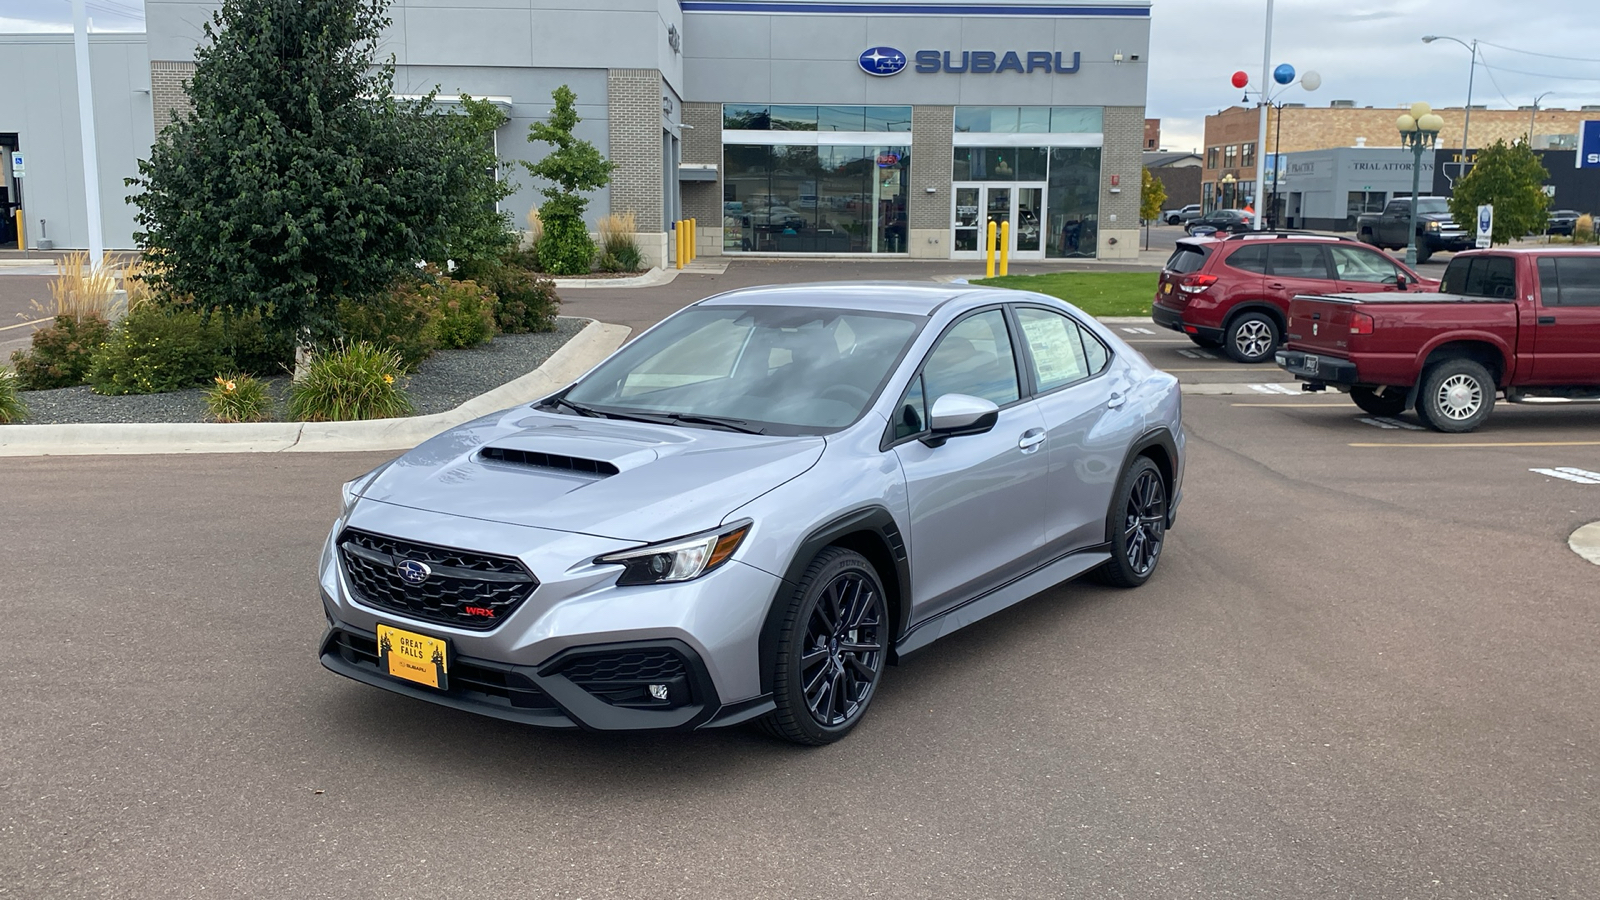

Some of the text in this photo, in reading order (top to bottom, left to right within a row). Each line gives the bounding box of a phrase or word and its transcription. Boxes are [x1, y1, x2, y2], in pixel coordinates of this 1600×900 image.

[915, 50, 1081, 74] SUBARU
[1587, 153, 1600, 163] S
[1353, 162, 1381, 171] TRIAL
[465, 606, 494, 617] WRX
[400, 637, 423, 649] GREAT
[400, 646, 424, 659] FALLS
[406, 663, 427, 673] SUBARU
